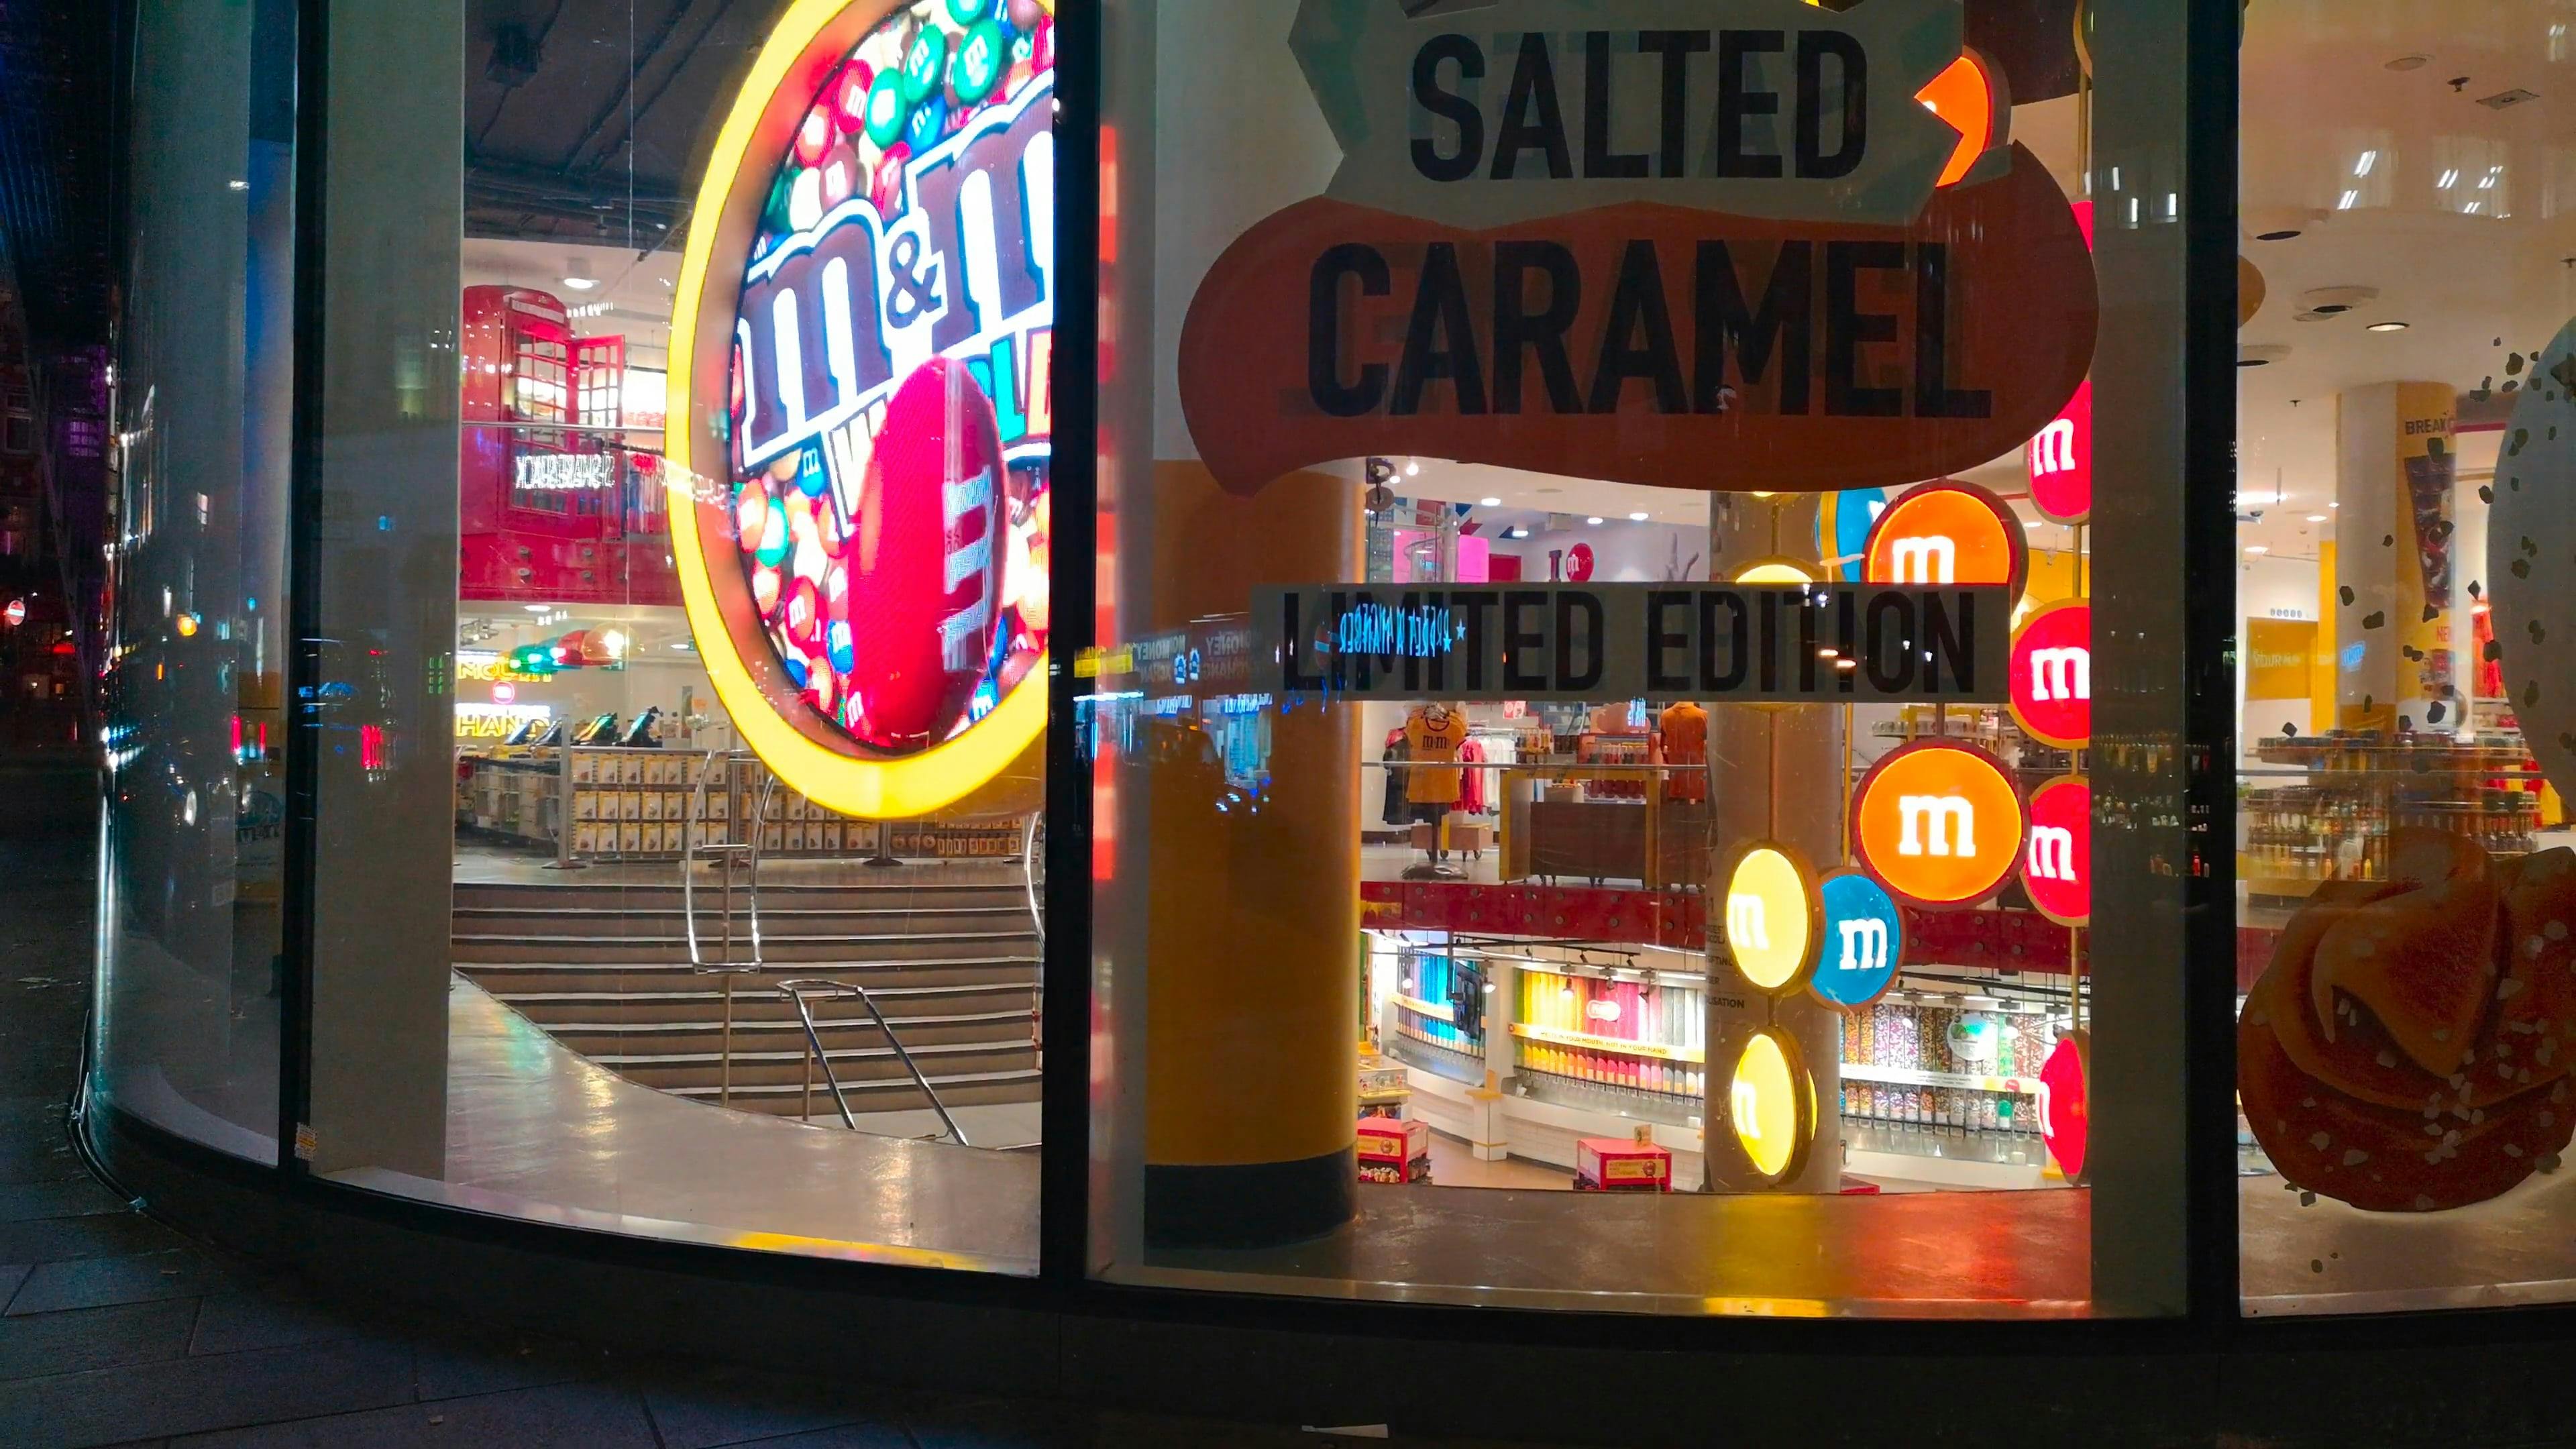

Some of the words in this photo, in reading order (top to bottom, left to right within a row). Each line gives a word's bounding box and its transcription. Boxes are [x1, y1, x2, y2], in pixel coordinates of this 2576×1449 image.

[1411, 30, 1867, 182] SALTED
[1309, 239, 1992, 417] CARAMEL
[2033, 418, 2076, 476] m
[1893, 535, 1955, 584] m
[1284, 591, 1603, 692] LIMITED
[1648, 591, 1974, 692] EDITION
[2031, 647, 2089, 702] m
[1898, 795, 1976, 857] m
[2028, 825, 2075, 880] m
[1729, 893, 1770, 951] m
[1838, 917, 1888, 970] m
